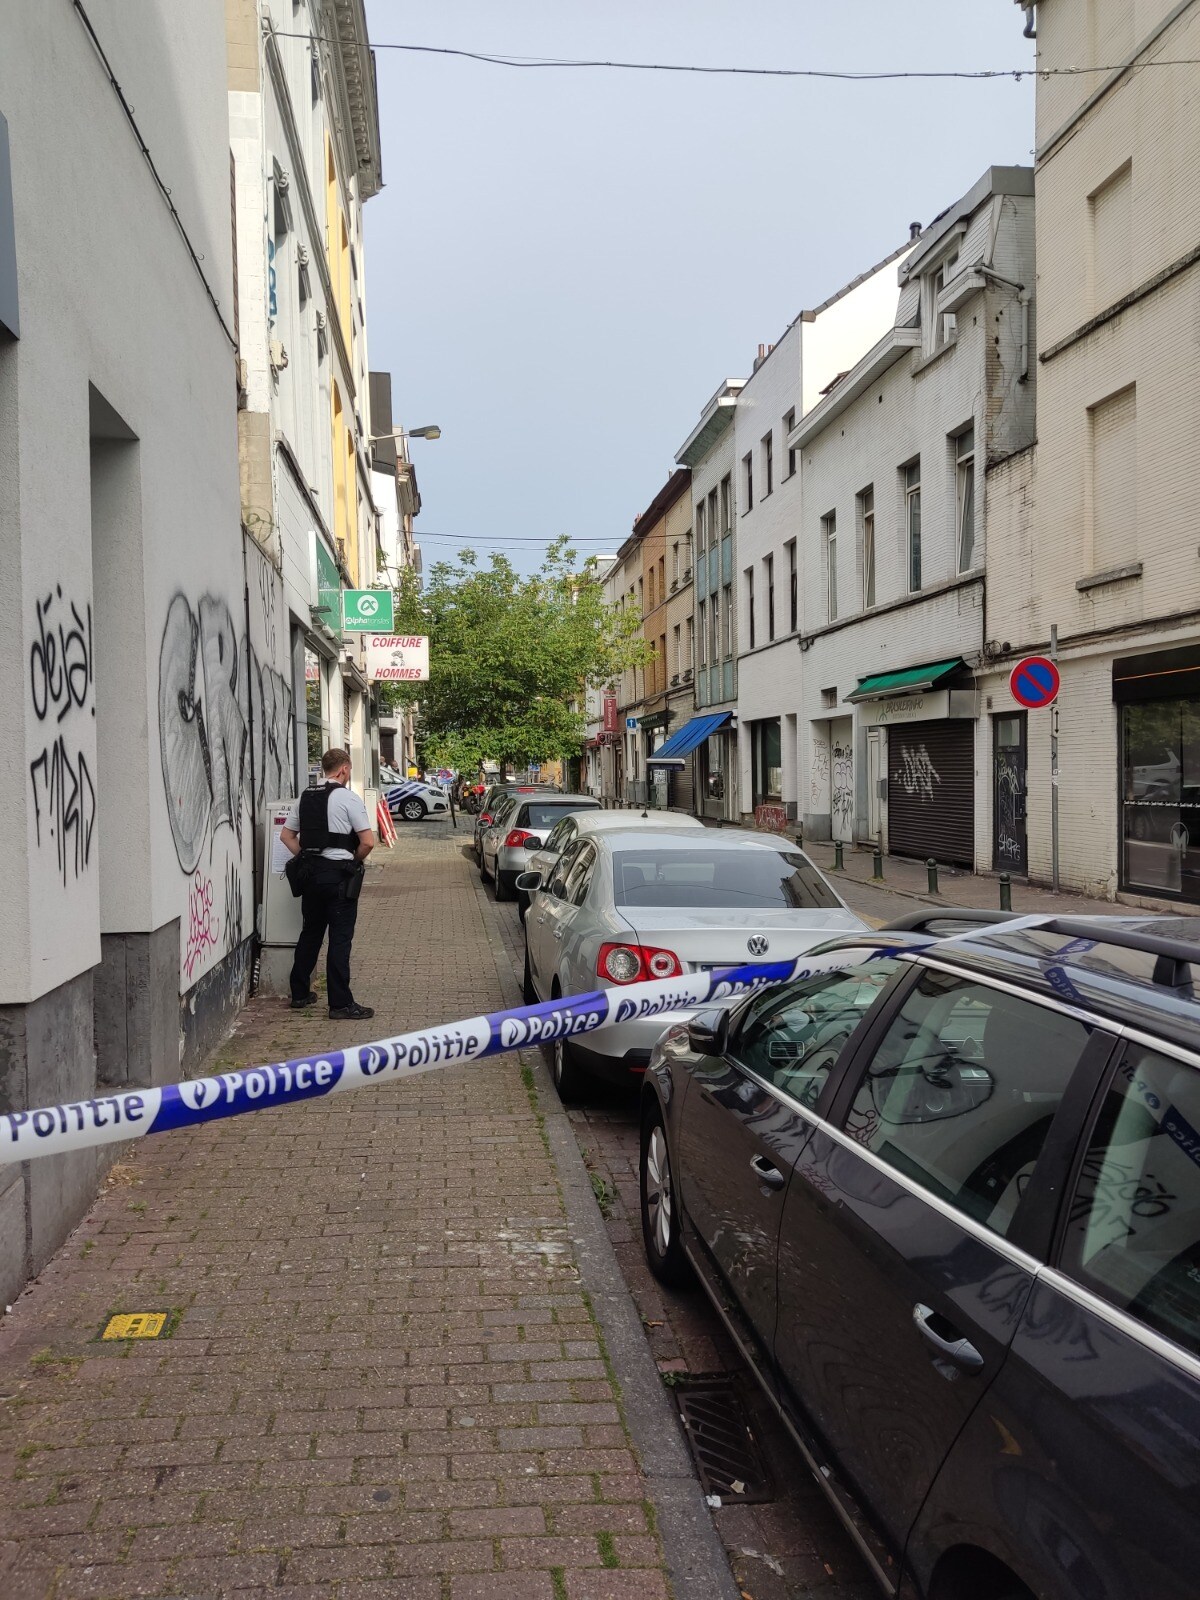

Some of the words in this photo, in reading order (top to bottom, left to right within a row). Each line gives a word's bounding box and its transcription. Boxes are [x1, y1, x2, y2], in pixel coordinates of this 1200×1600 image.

[372, 637, 422, 648] COIFFURE
[374, 668, 422, 679] HOMMES
[8, 1095, 145, 1142] Politie
[226, 1059, 333, 1103] Police
[392, 1029, 479, 1070] Politie
[526, 1010, 599, 1043] Police
[635, 991, 697, 1018] Politie
